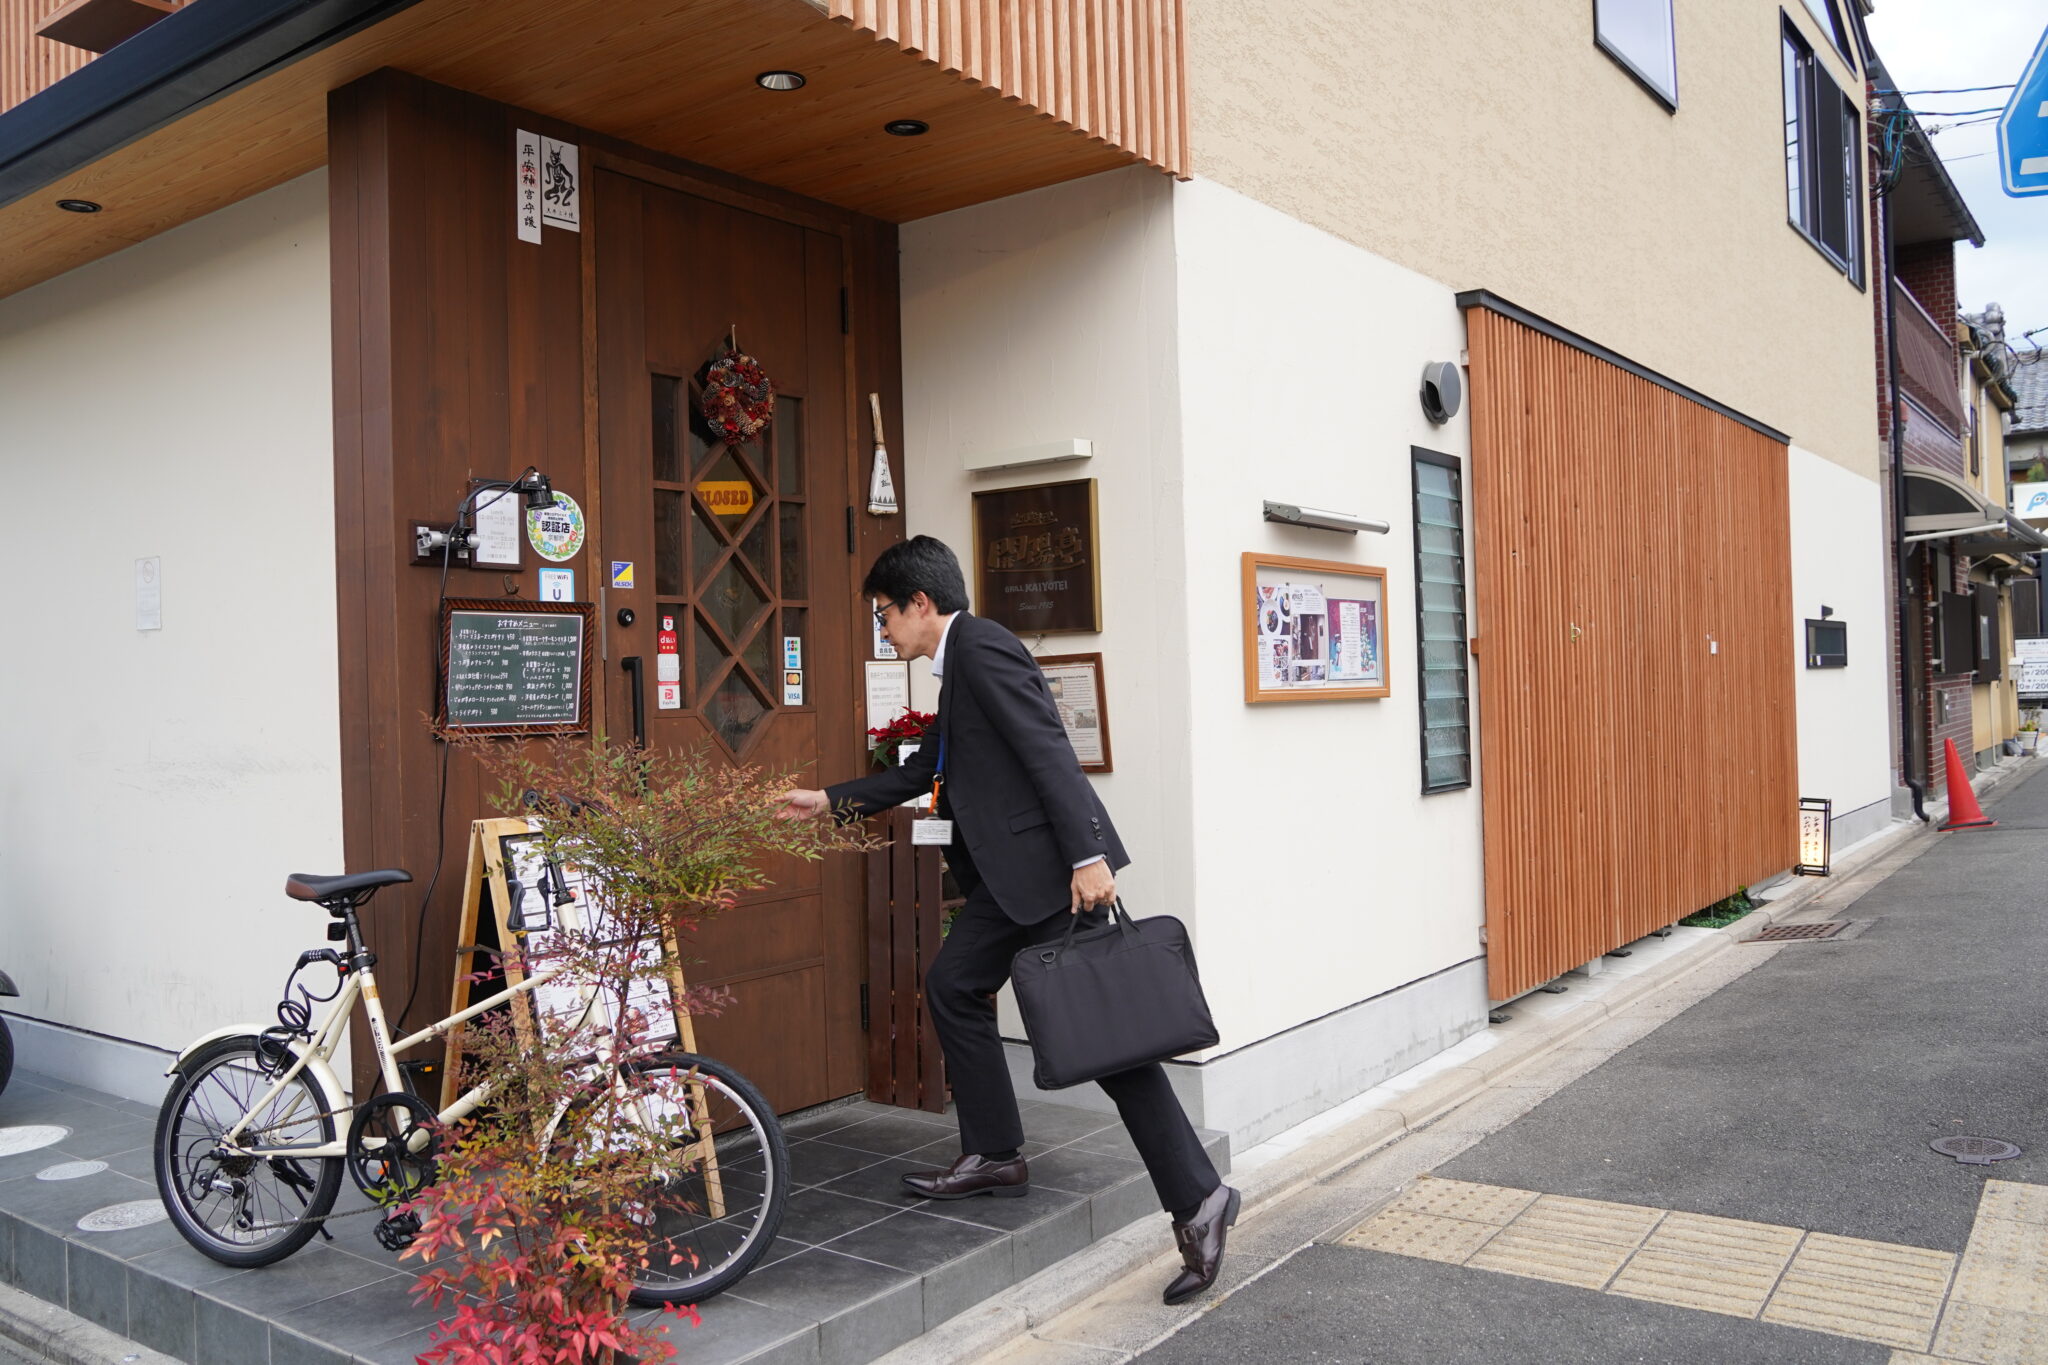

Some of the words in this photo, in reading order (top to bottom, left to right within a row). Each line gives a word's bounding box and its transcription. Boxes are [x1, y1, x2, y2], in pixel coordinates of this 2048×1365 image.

[523, 144, 537, 229] 平安神宮守護
[541, 520, 570, 534] 認証店
[1025, 580, 1068, 592] KAIYOTEI
[497, 619, 539, 628] おすすめメニュー
[787, 692, 801, 700] VISA
